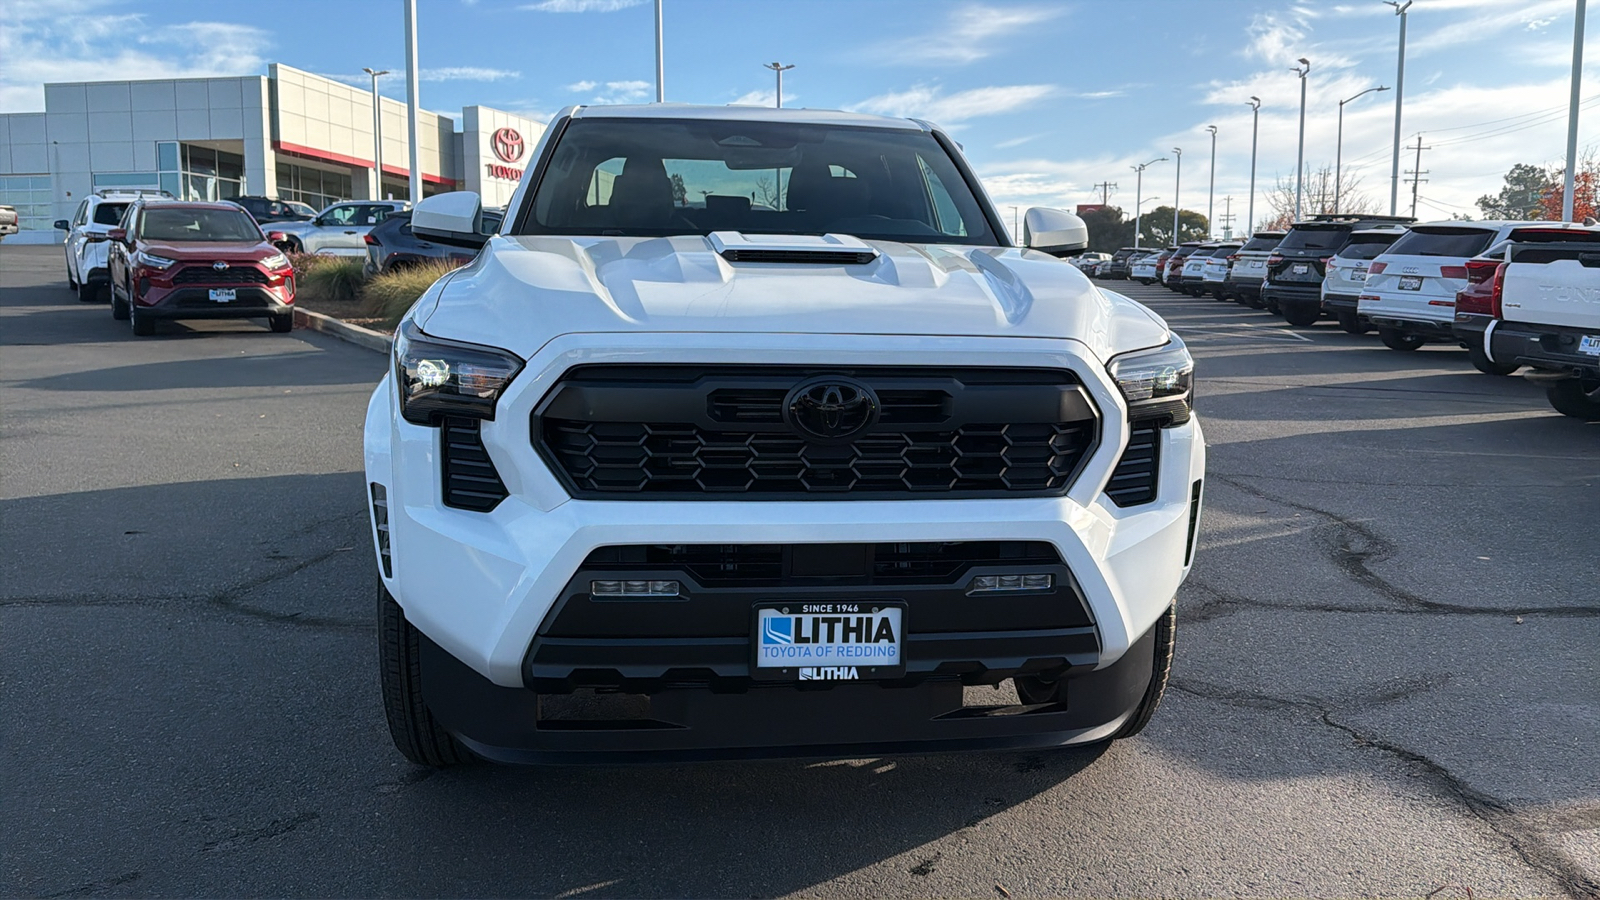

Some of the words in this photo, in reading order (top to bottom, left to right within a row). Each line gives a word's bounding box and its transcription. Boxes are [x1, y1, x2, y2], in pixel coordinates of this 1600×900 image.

[802, 604, 833, 613] SINCE
[836, 604, 859, 613] 1946
[794, 616, 896, 644] LITHIA
[763, 646, 812, 658] TOYOTA
[815, 646, 834, 657] OF
[836, 645, 896, 657] REDDING
[812, 666, 859, 680] LITHIA
